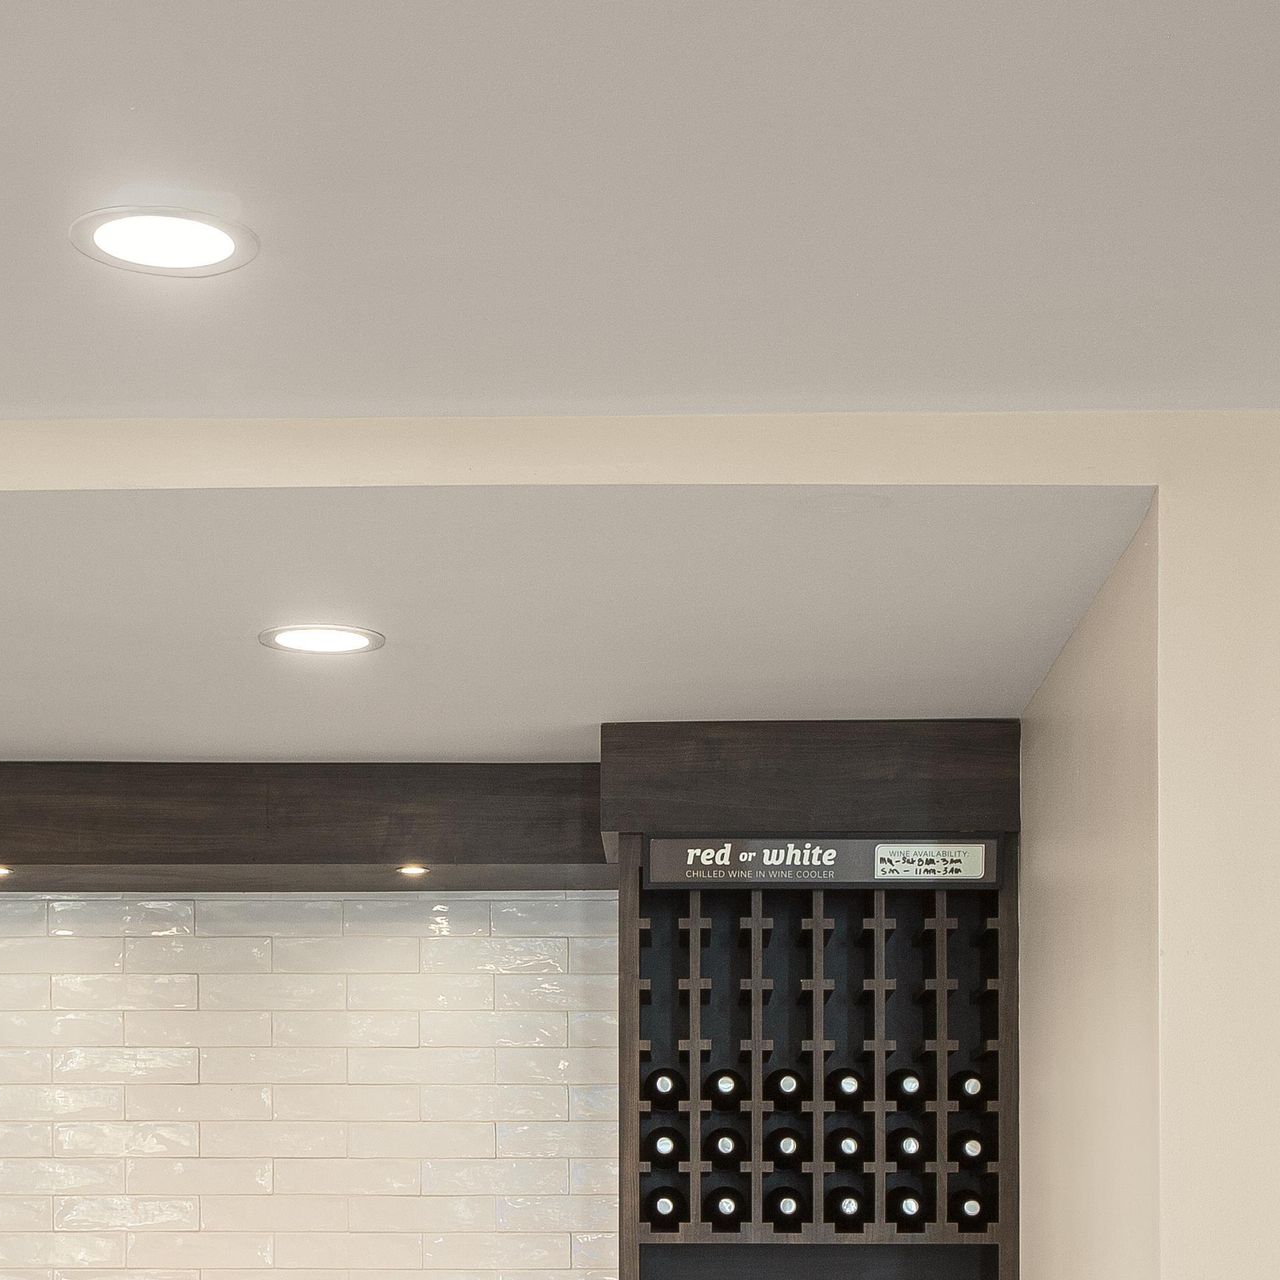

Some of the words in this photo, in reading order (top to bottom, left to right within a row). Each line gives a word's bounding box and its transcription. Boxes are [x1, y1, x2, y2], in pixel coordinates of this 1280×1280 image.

[686, 843, 732, 866] red
[739, 851, 756, 862] or
[762, 843, 837, 866] white
[889, 850, 910, 858] WINE
[913, 850, 971, 858] AVAILABILITY:
[685, 870, 725, 878] CHILLED
[728, 870, 753, 878] WINE
[755, 870, 766, 878] IN
[768, 870, 793, 878] WINE
[796, 870, 835, 878] COOLER
